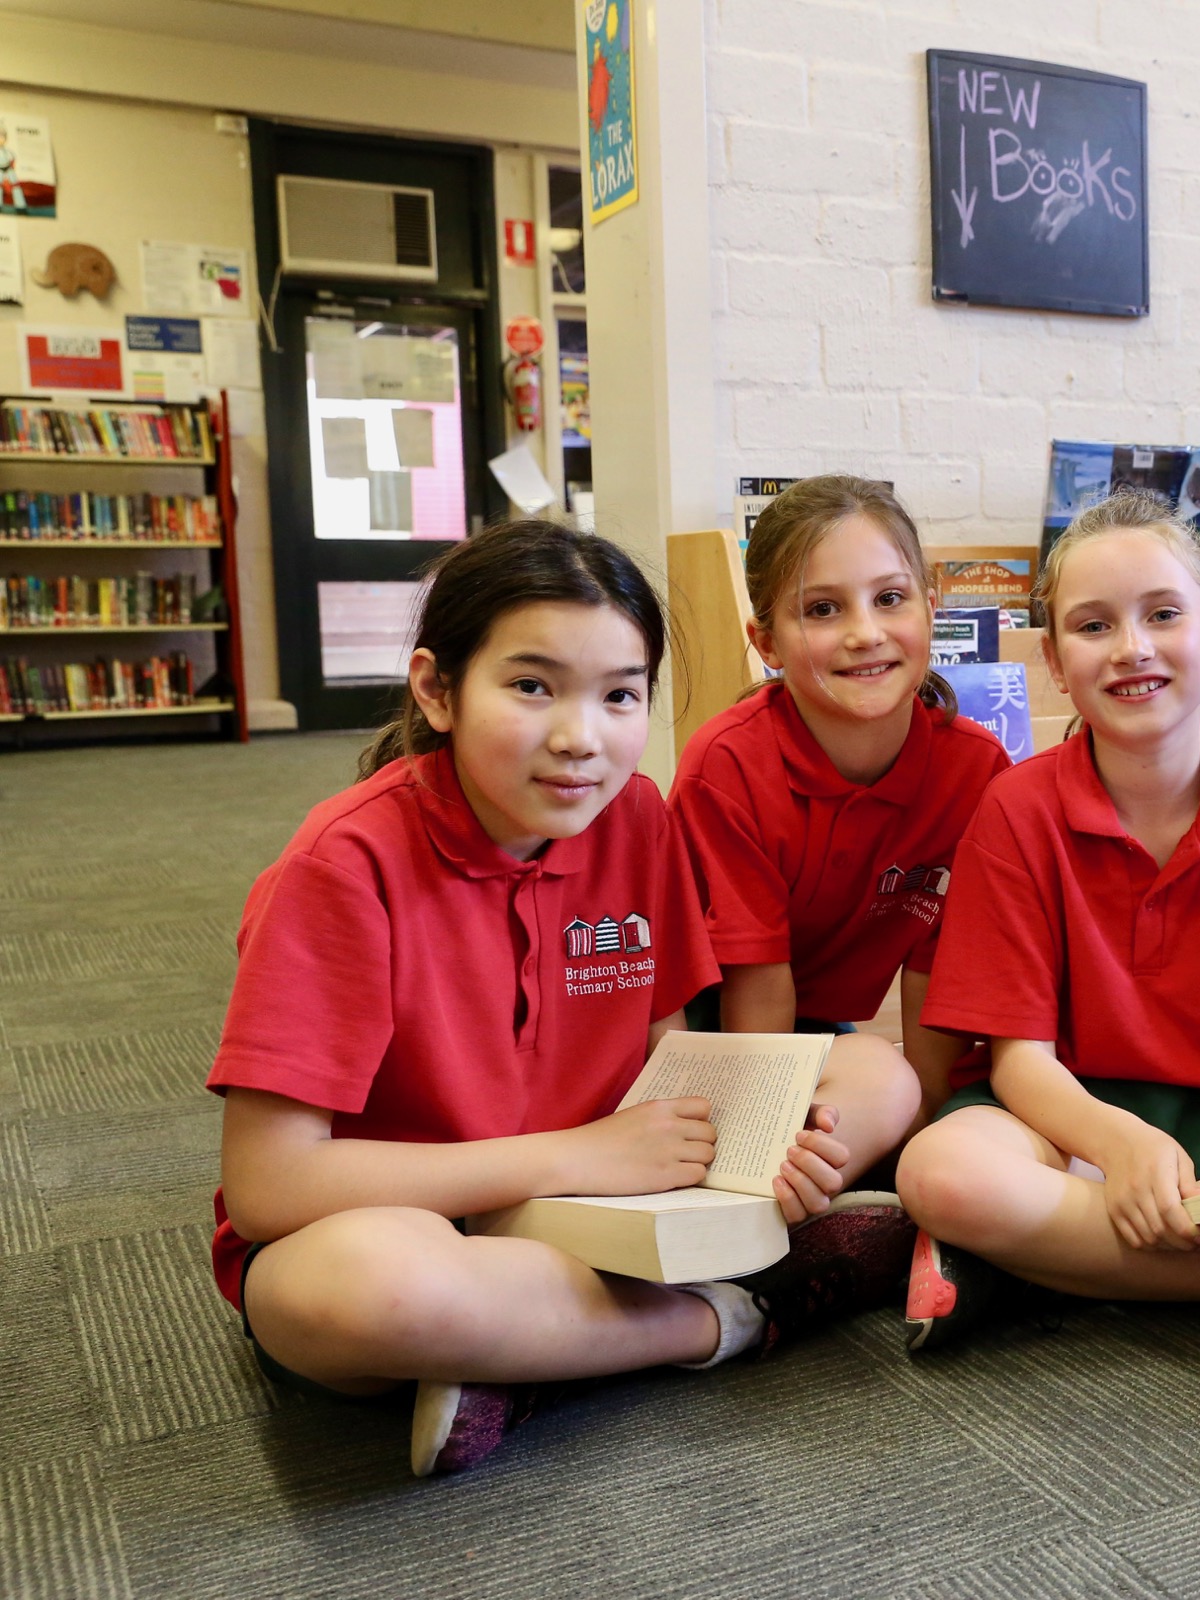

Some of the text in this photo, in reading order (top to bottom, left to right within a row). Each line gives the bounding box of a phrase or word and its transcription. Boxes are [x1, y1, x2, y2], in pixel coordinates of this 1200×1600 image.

[959, 69, 1041, 130] NEW
[607, 119, 624, 147] THE
[590, 140, 634, 206] LORAX
[963, 565, 1010, 579] THE SHOP
[950, 584, 1023, 593] HOOPERS BEND
[564, 957, 655, 981] Brighton Beach
[566, 971, 655, 996] Primary School
